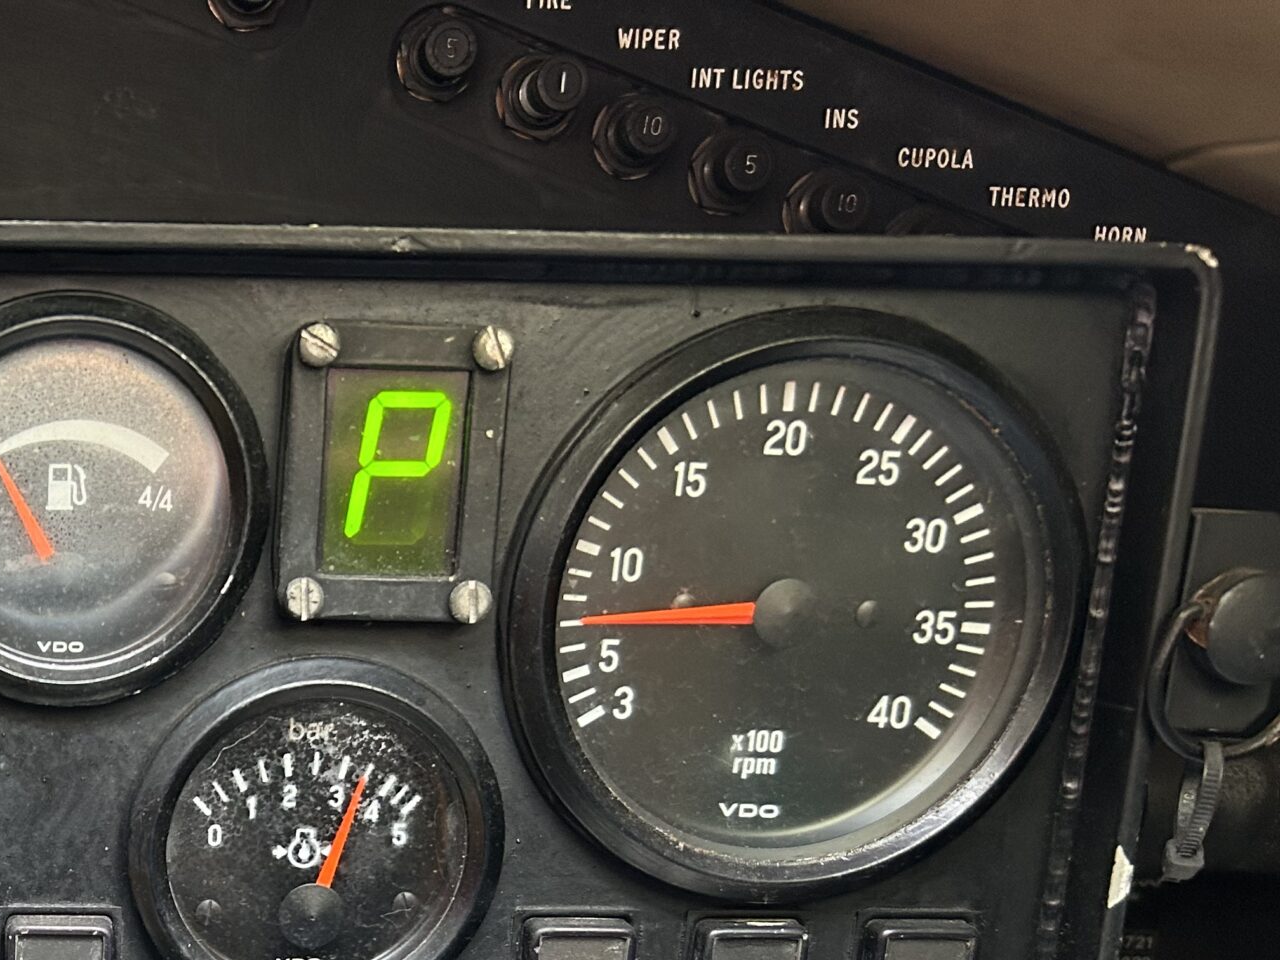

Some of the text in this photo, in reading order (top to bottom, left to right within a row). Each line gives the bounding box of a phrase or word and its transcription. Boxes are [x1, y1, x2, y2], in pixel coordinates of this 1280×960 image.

[618, 28, 681, 50] WIPER
[691, 68, 805, 92] INT LIGHTS
[642, 115, 662, 136] 10
[824, 107, 860, 130] INS
[745, 154, 758, 174] 5
[898, 147, 975, 170] CUPOLA
[838, 193, 857, 213] 10
[989, 186, 1071, 209] THERMO
[1094, 225, 1147, 243] HORN
[763, 419, 809, 456] 20
[343, 390, 452, 539] P
[856, 450, 902, 487] 25
[674, 461, 708, 498] 15
[137, 485, 173, 512] 4/4
[904, 518, 948, 554] 30
[611, 547, 644, 583] 10
[913, 610, 958, 646] 35
[36, 640, 85, 653] VDO
[598, 638, 621, 673] 5
[612, 686, 635, 720] 3
[867, 695, 912, 730] 40
[730, 729, 784, 753] x100
[732, 755, 777, 779] rpm
[246, 795, 258, 820] 1
[282, 784, 298, 810] 2
[328, 784, 345, 808] 3
[364, 798, 380, 823] 4
[718, 802, 780, 819] VDO
[207, 823, 222, 847] 0
[391, 823, 408, 847] 5
